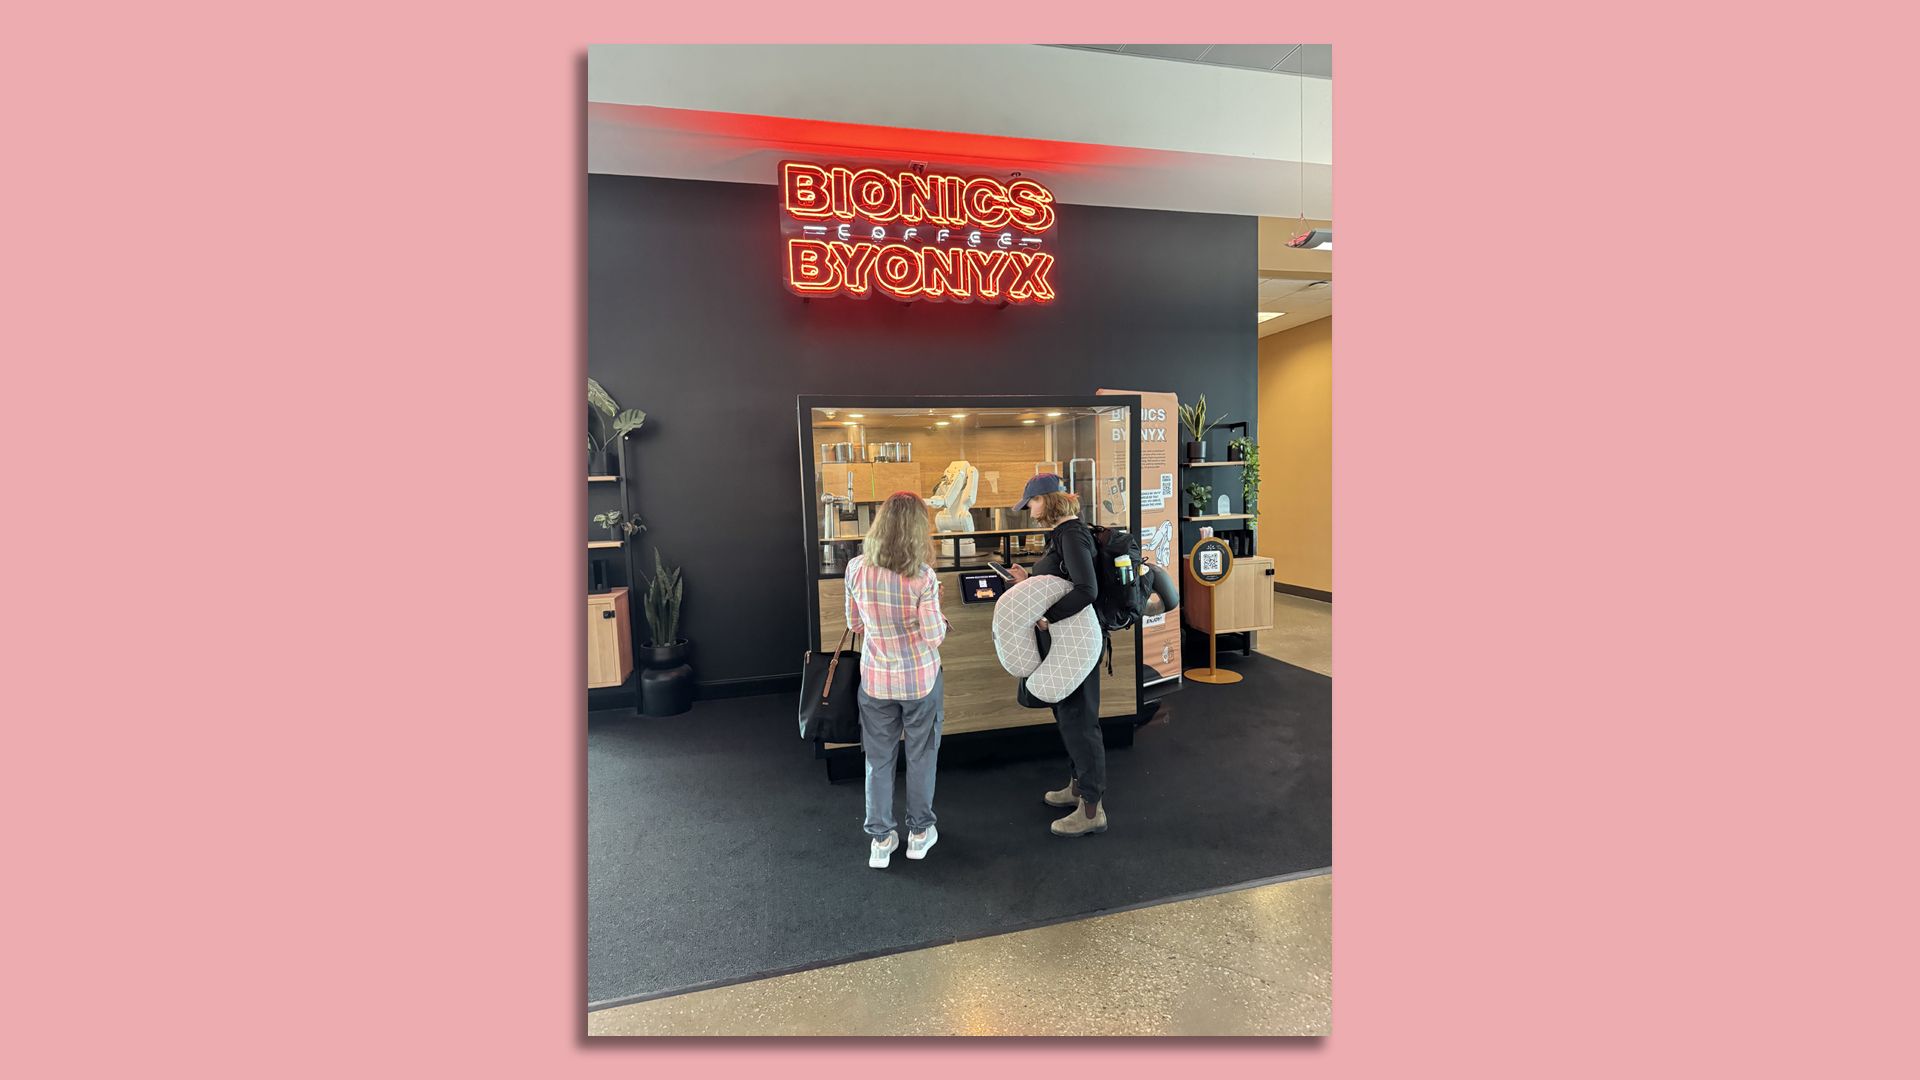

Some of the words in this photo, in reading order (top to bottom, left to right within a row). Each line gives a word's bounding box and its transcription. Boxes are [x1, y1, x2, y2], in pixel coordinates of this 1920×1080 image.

[784, 163, 1055, 232] BIONICS
[837, 223, 1012, 248] COFFEE
[787, 239, 1055, 300] BYONYX
[1112, 428, 1166, 441] BYNYX
